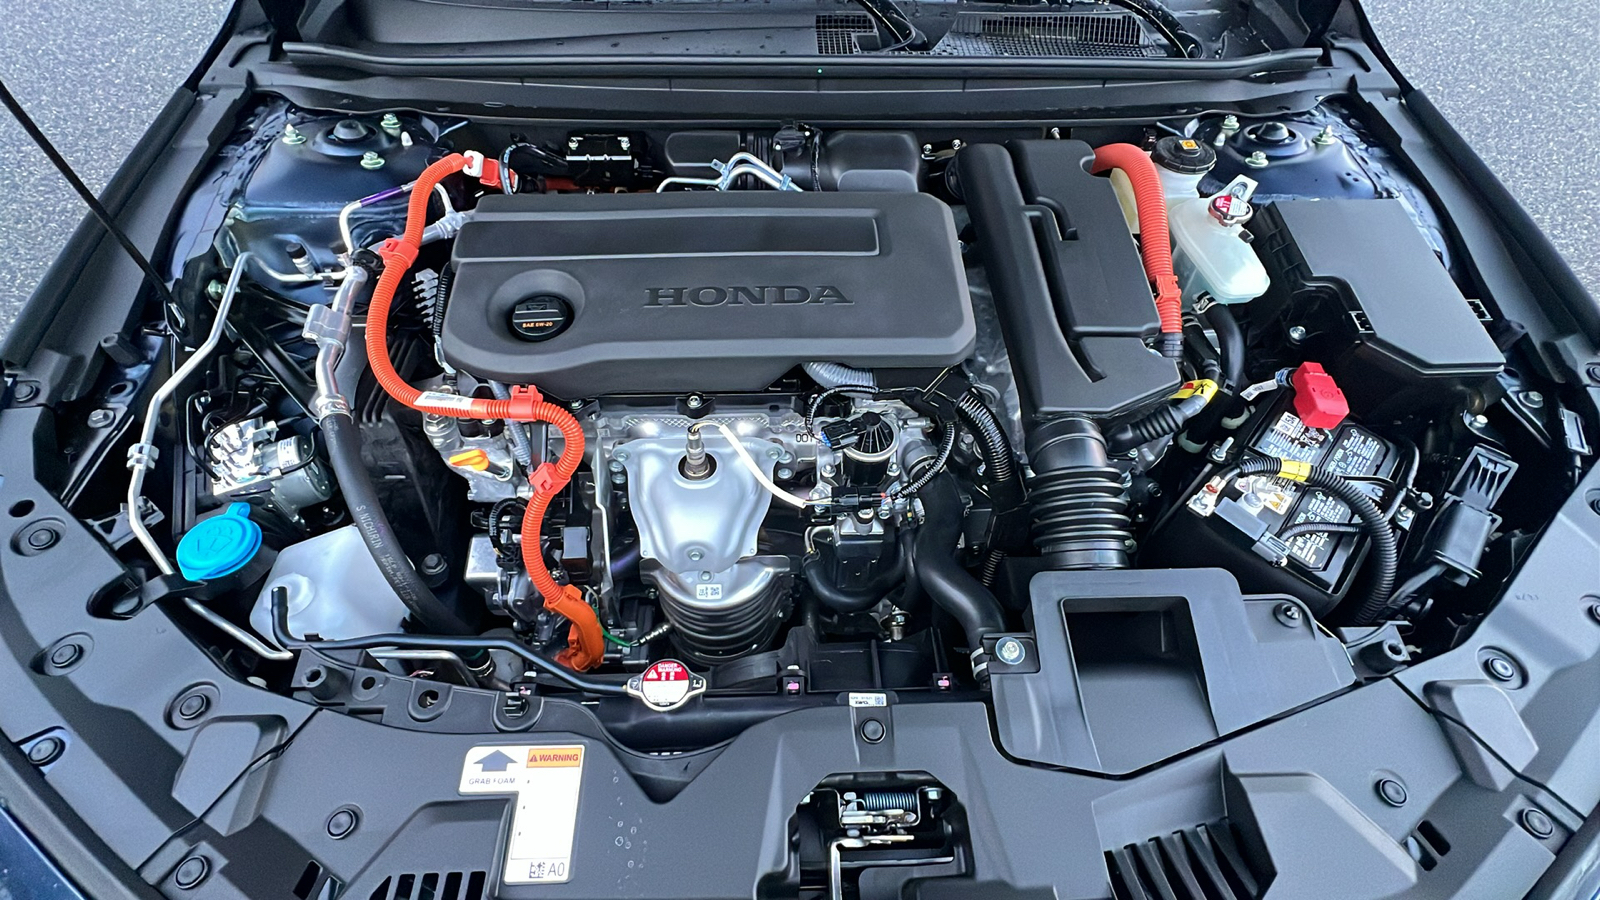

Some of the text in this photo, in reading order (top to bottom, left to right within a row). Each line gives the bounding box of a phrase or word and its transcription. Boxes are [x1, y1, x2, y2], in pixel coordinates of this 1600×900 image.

[643, 285, 855, 308] HONDA
[360, 512, 384, 549] NICHIRIN
[539, 753, 579, 762] WARNING
[468, 777, 491, 785] GRAB
